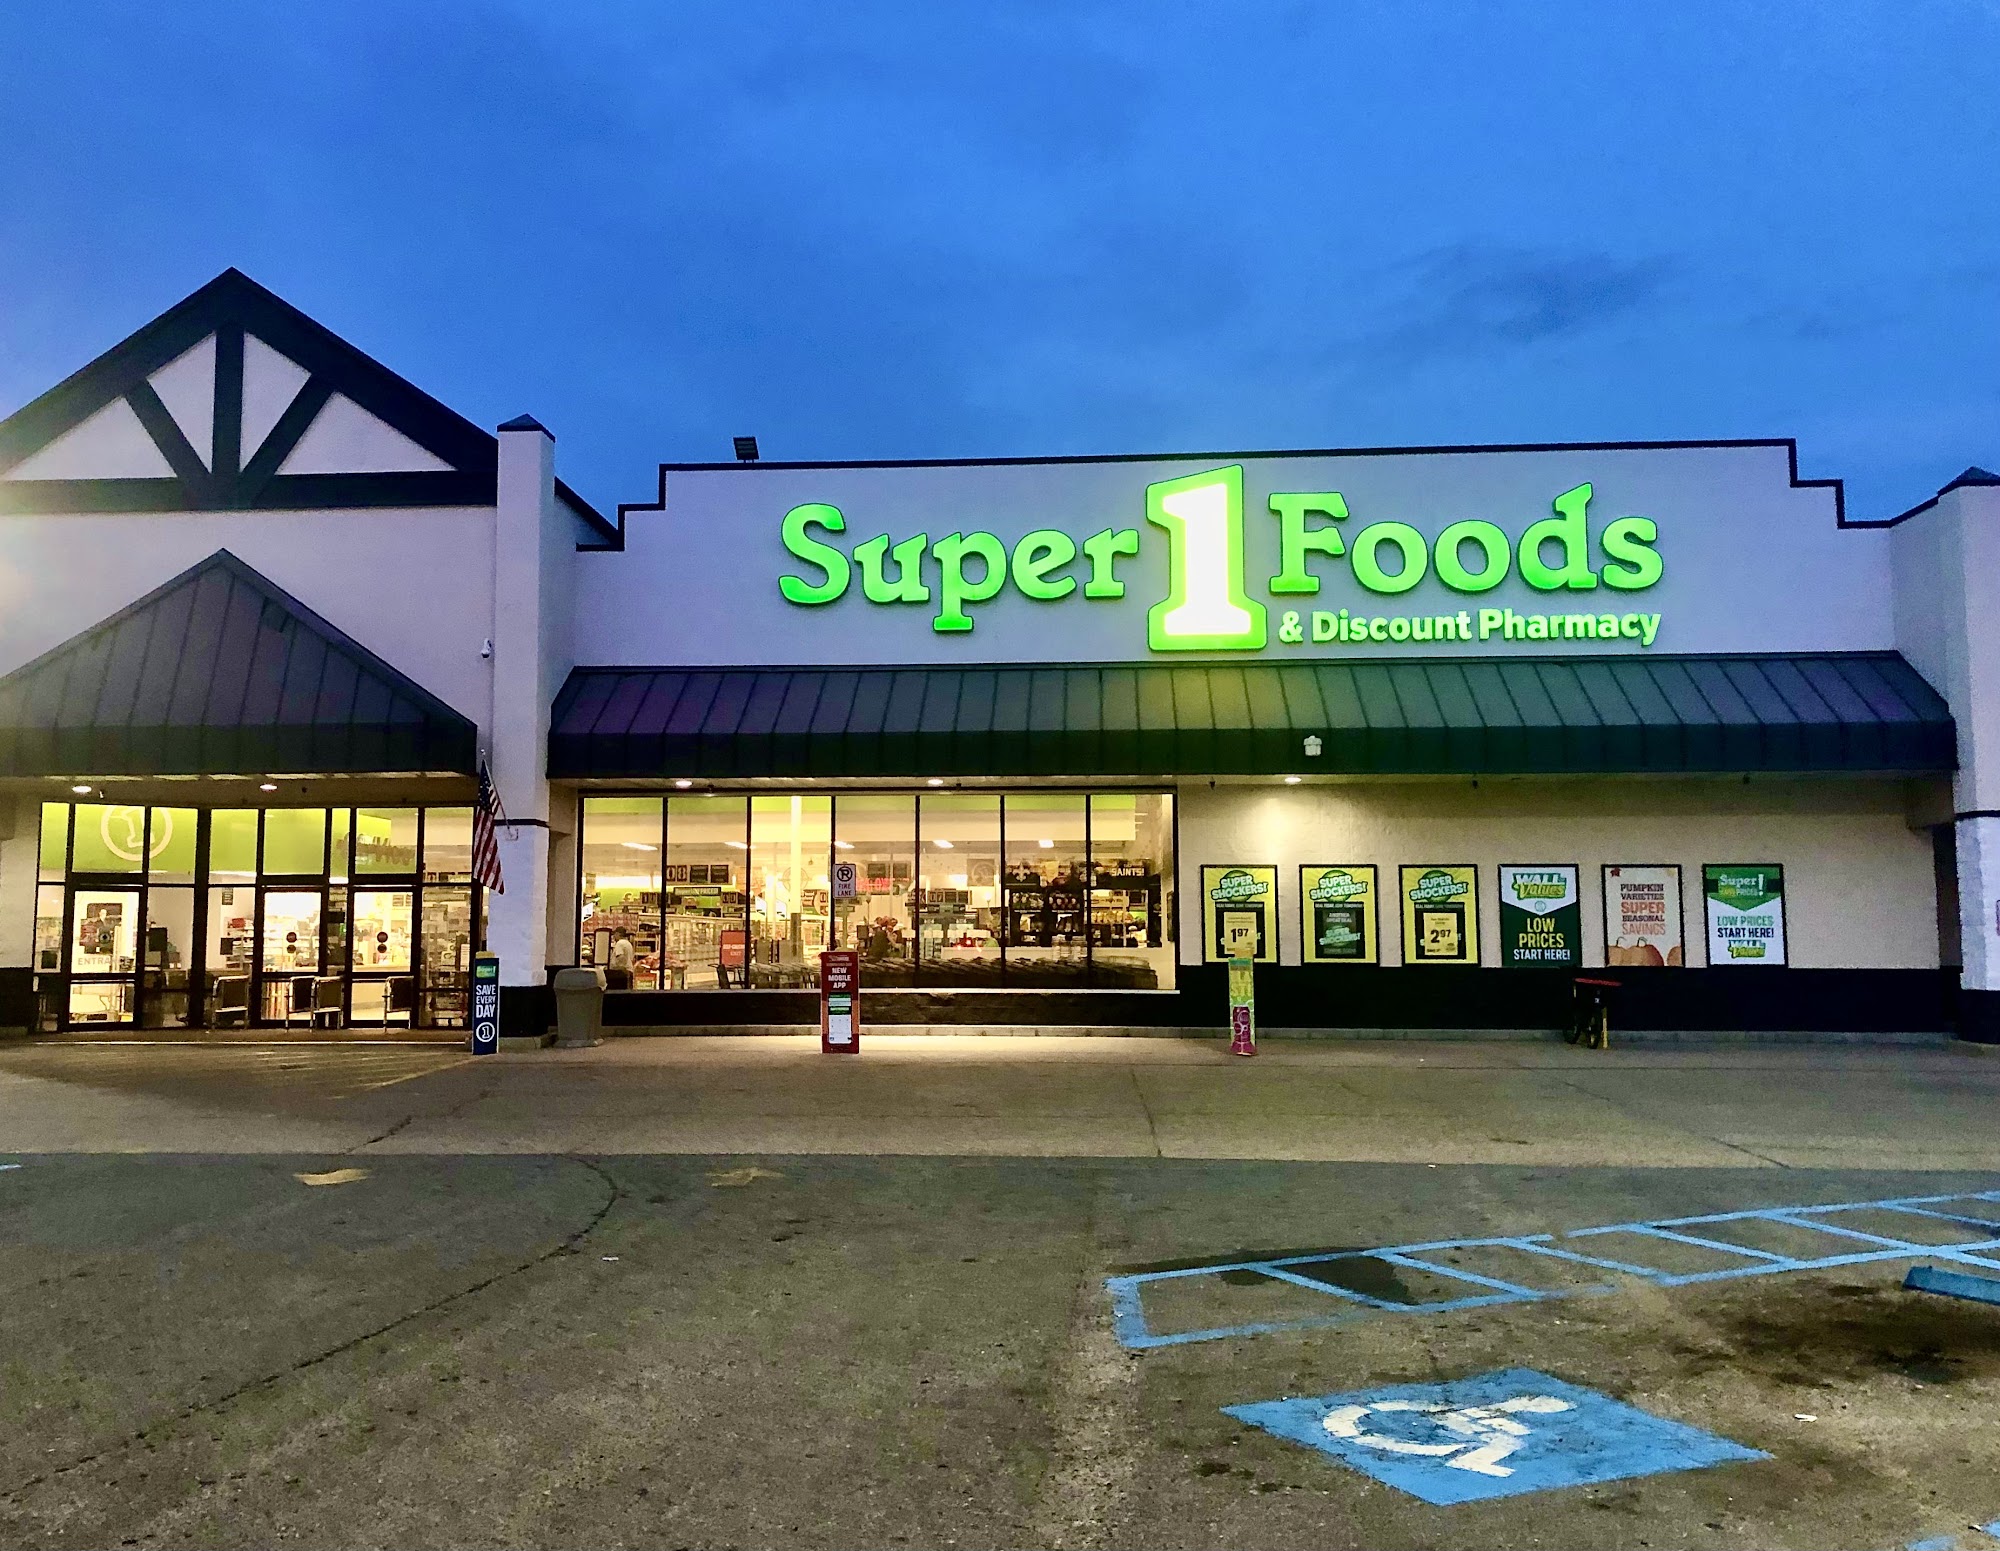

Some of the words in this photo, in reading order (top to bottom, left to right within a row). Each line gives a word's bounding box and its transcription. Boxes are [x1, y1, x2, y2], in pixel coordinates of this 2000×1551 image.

[778, 502, 1140, 632] Super
[1146, 464, 1267, 651] 1
[1268, 482, 1664, 594] Foods
[1279, 610, 1303, 642] &
[1312, 608, 1472, 642] Discount
[1479, 608, 1661, 646] Pharmacy
[1111, 868, 1145, 876] SAINTS!
[1221, 875, 1253, 888] SUPER
[1319, 875, 1352, 888] SUPER
[1420, 875, 1452, 888] SUPER
[1516, 874, 1565, 884] WALL
[1720, 874, 1757, 888] Super
[1212, 882, 1268, 899] SHOCKERS!
[1310, 882, 1367, 899] SHOCKERS!
[1410, 883, 1467, 899] SHOCKERS!
[1513, 883, 1564, 898] Values
[1621, 902, 1665, 913] SUPER
[1527, 918, 1555, 932] LOW
[1717, 916, 1738, 926] LOW
[1741, 916, 1774, 926] PRICES
[1622, 923, 1665, 935] SAVINGS
[1718, 928, 1746, 937] START
[1748, 928, 1774, 937] HERE!
[1519, 933, 1564, 947] PRICES
[1514, 949, 1542, 959] START
[1544, 949, 1570, 959] HERE!
[476, 984, 496, 995] SAVE
[476, 996, 496, 1004] EVERY
[476, 1004, 496, 1018] DAY
